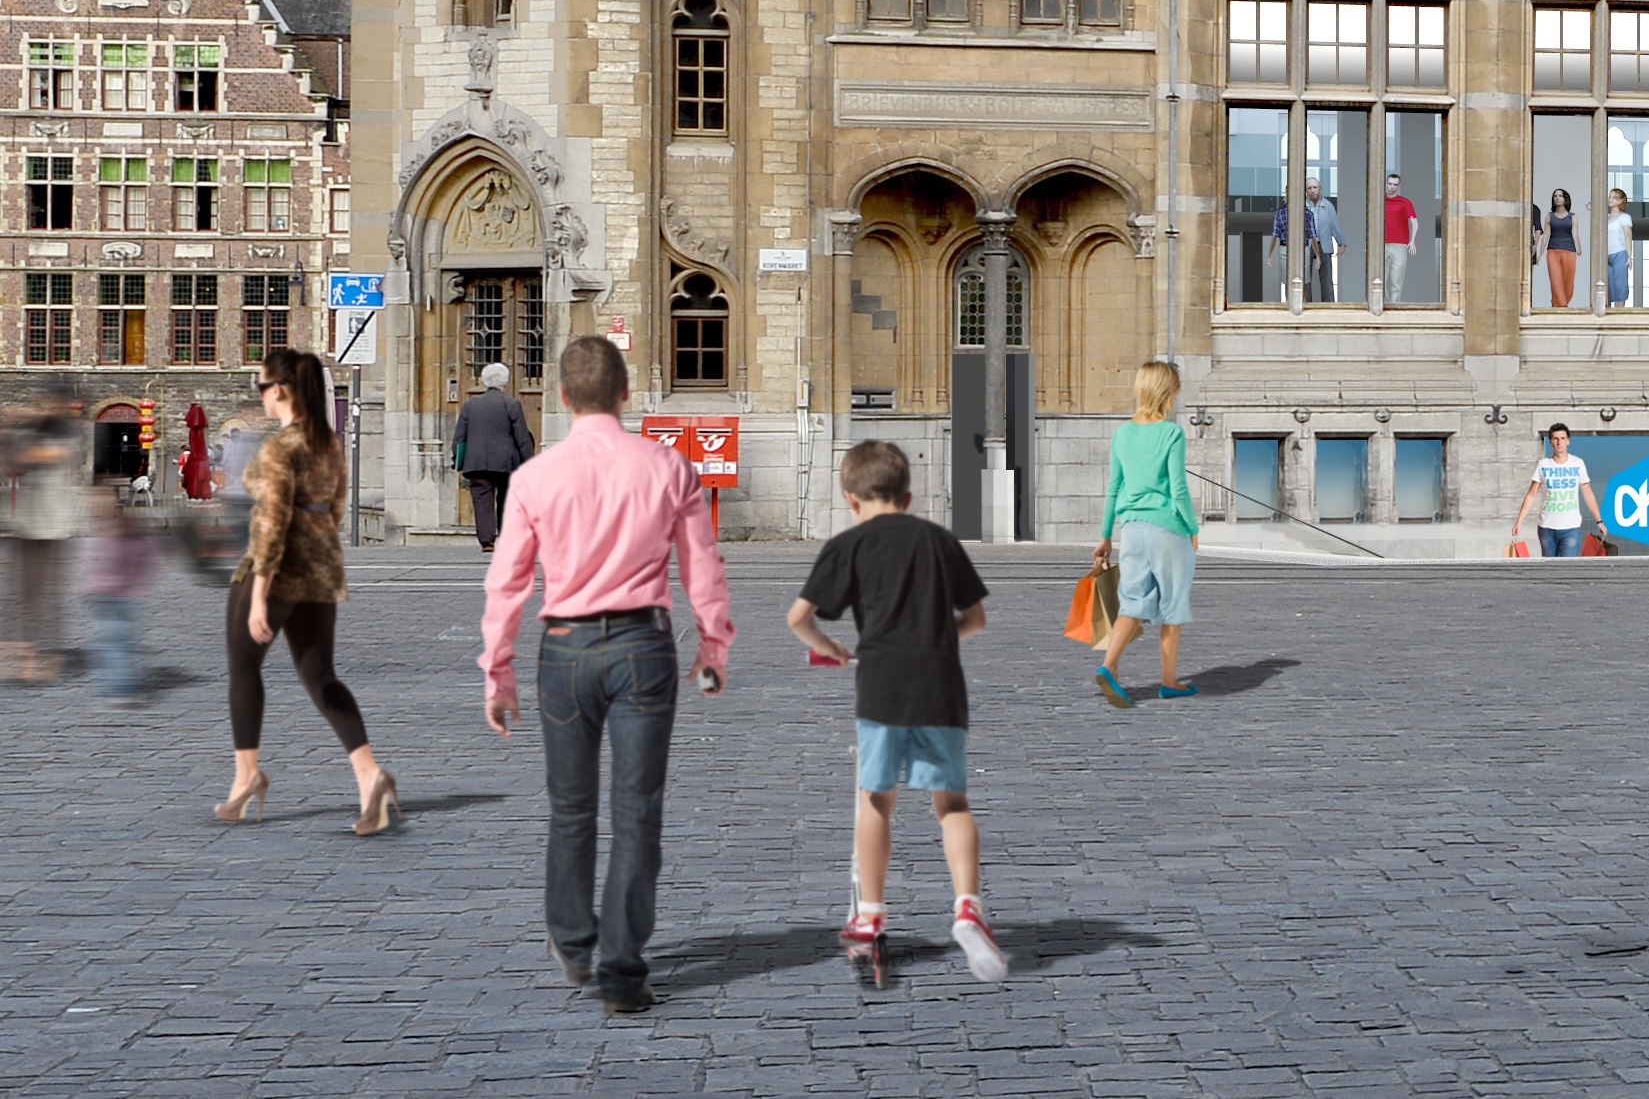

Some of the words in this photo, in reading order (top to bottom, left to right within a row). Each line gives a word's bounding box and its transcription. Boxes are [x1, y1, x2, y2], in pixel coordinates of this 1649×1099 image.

[1541, 467, 1580, 477] THINK
[1546, 478, 1577, 489] LESS
[1547, 490, 1575, 501] LIVE
[1543, 500, 1578, 512] MORE
